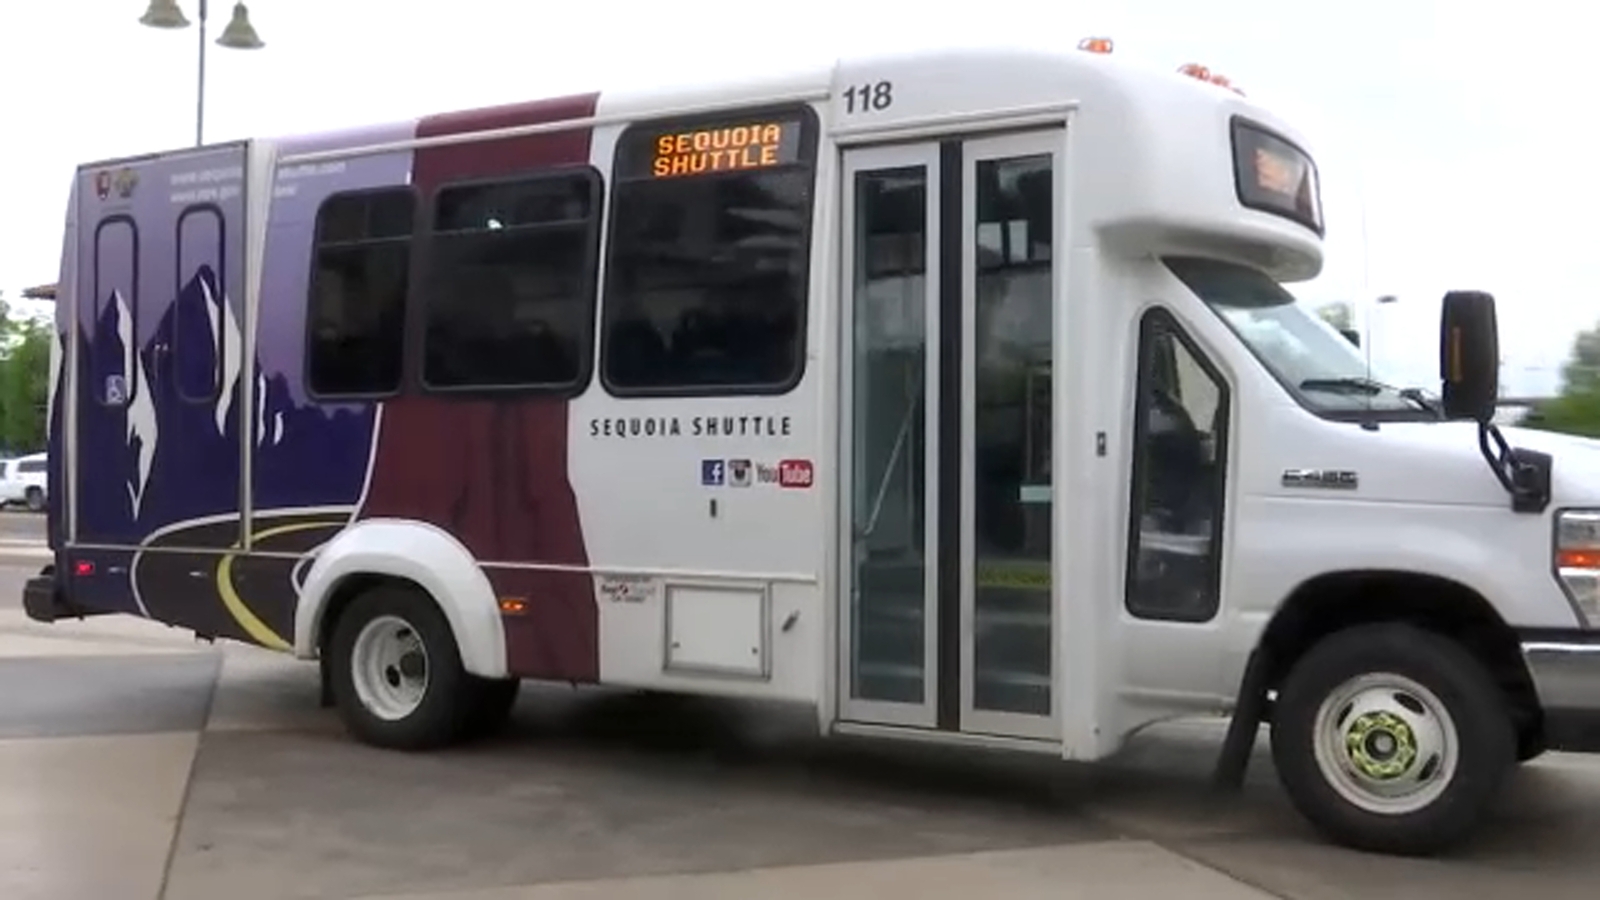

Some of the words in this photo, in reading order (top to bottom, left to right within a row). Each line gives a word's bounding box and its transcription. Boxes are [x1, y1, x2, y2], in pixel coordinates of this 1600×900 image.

[843, 81, 893, 114] 118
[658, 123, 781, 156] SEQUOIA
[654, 145, 779, 177] SHUTTLE
[590, 418, 681, 438] SEQUOIA
[692, 416, 792, 436] SHUTTLE
